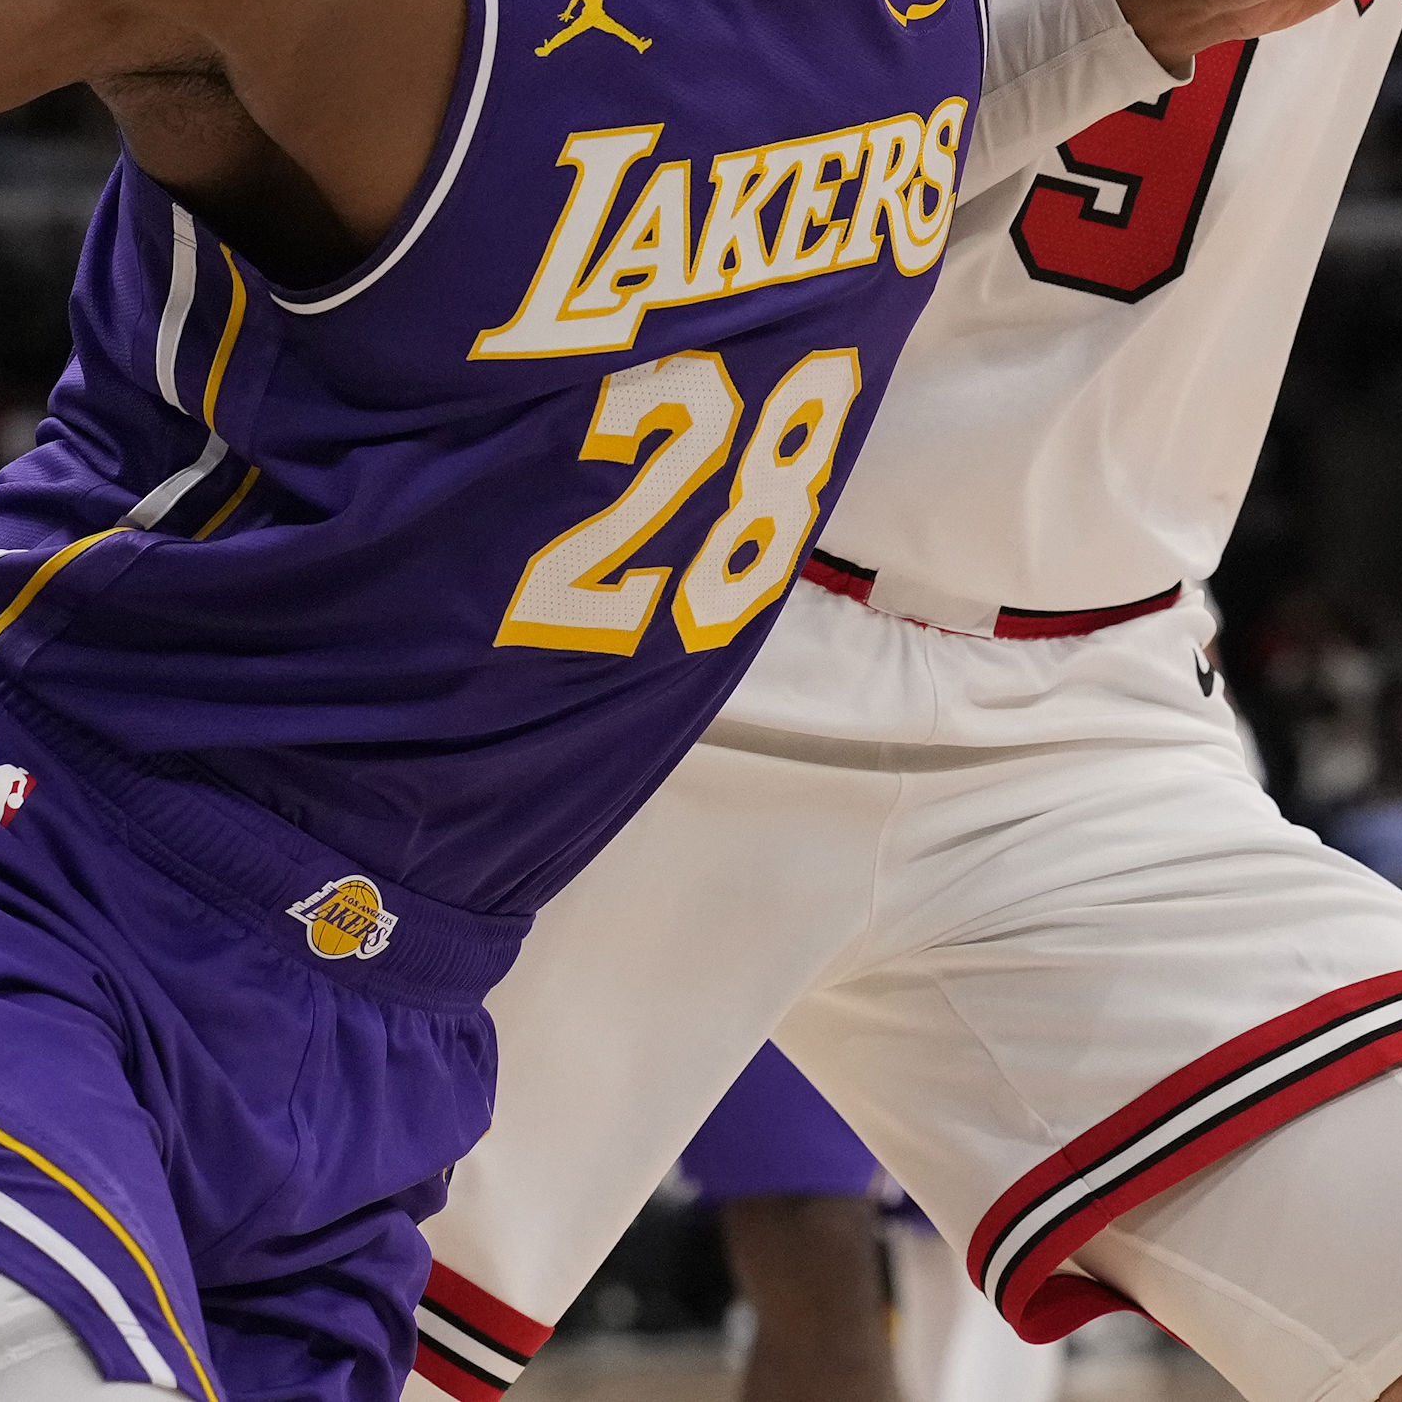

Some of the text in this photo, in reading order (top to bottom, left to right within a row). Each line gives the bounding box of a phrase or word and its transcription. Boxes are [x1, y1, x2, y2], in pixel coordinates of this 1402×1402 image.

[466, 96, 969, 361] LAKERS
[493, 348, 863, 657] 28
[294, 885, 389, 955] LAKERS
[342, 894, 394, 927] LOS ANGELES
